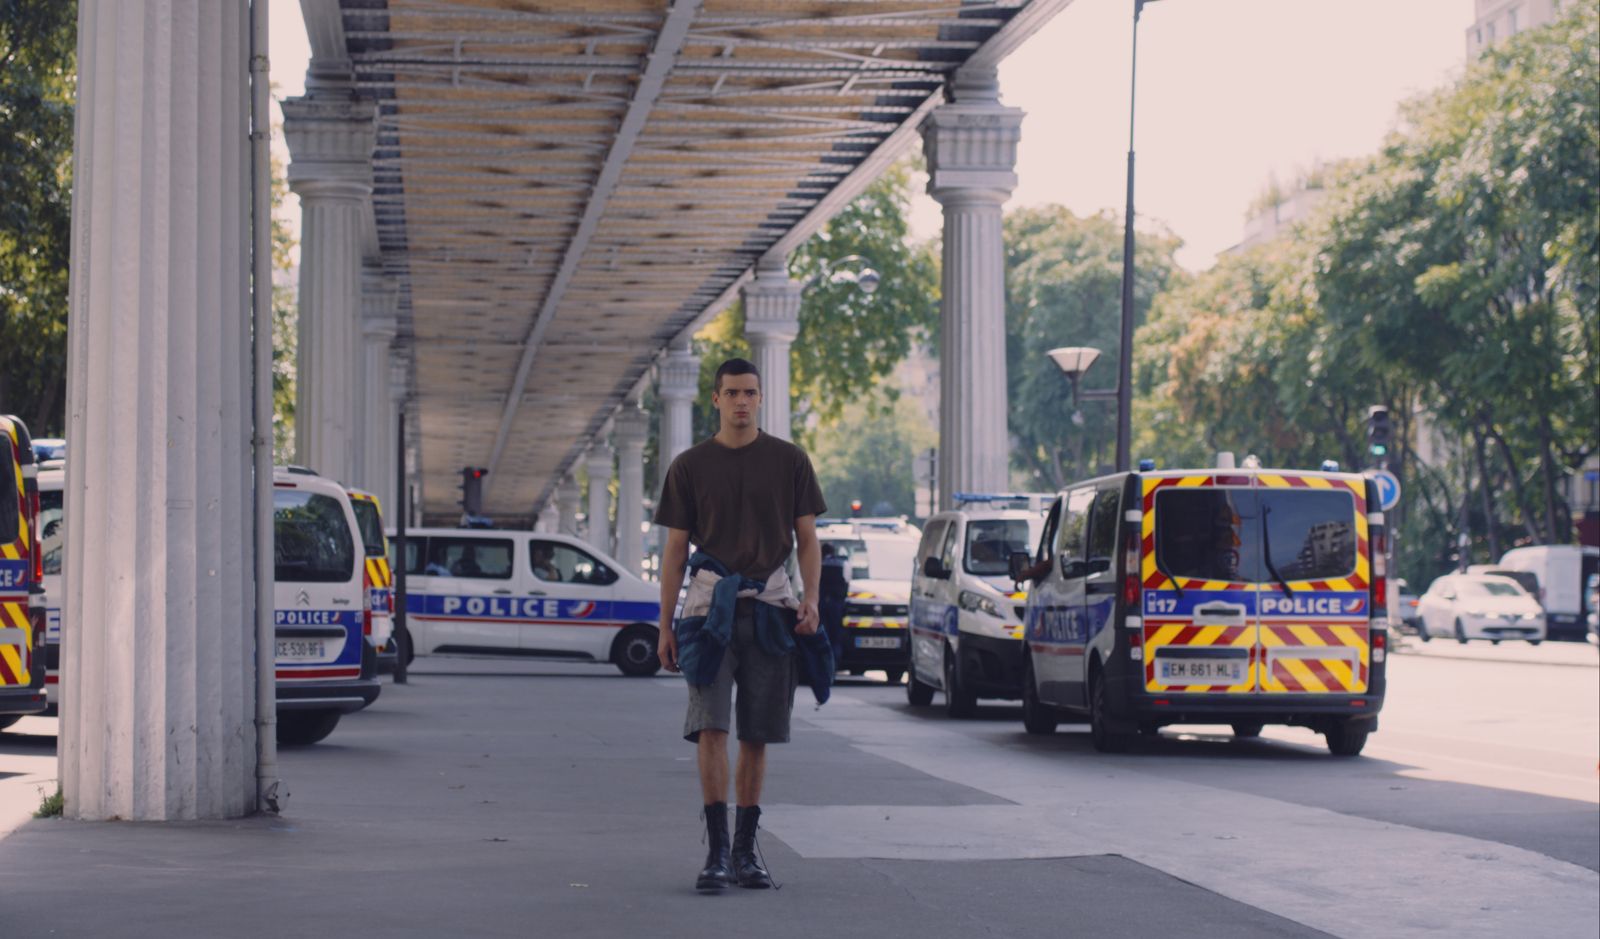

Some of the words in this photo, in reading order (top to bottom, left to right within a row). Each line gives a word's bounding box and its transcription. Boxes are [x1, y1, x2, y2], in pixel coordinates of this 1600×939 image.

[444, 597, 559, 618] POLICE
[1157, 599, 1177, 613] 17
[1262, 598, 1341, 614] POLICE
[276, 612, 329, 624] POLICE
